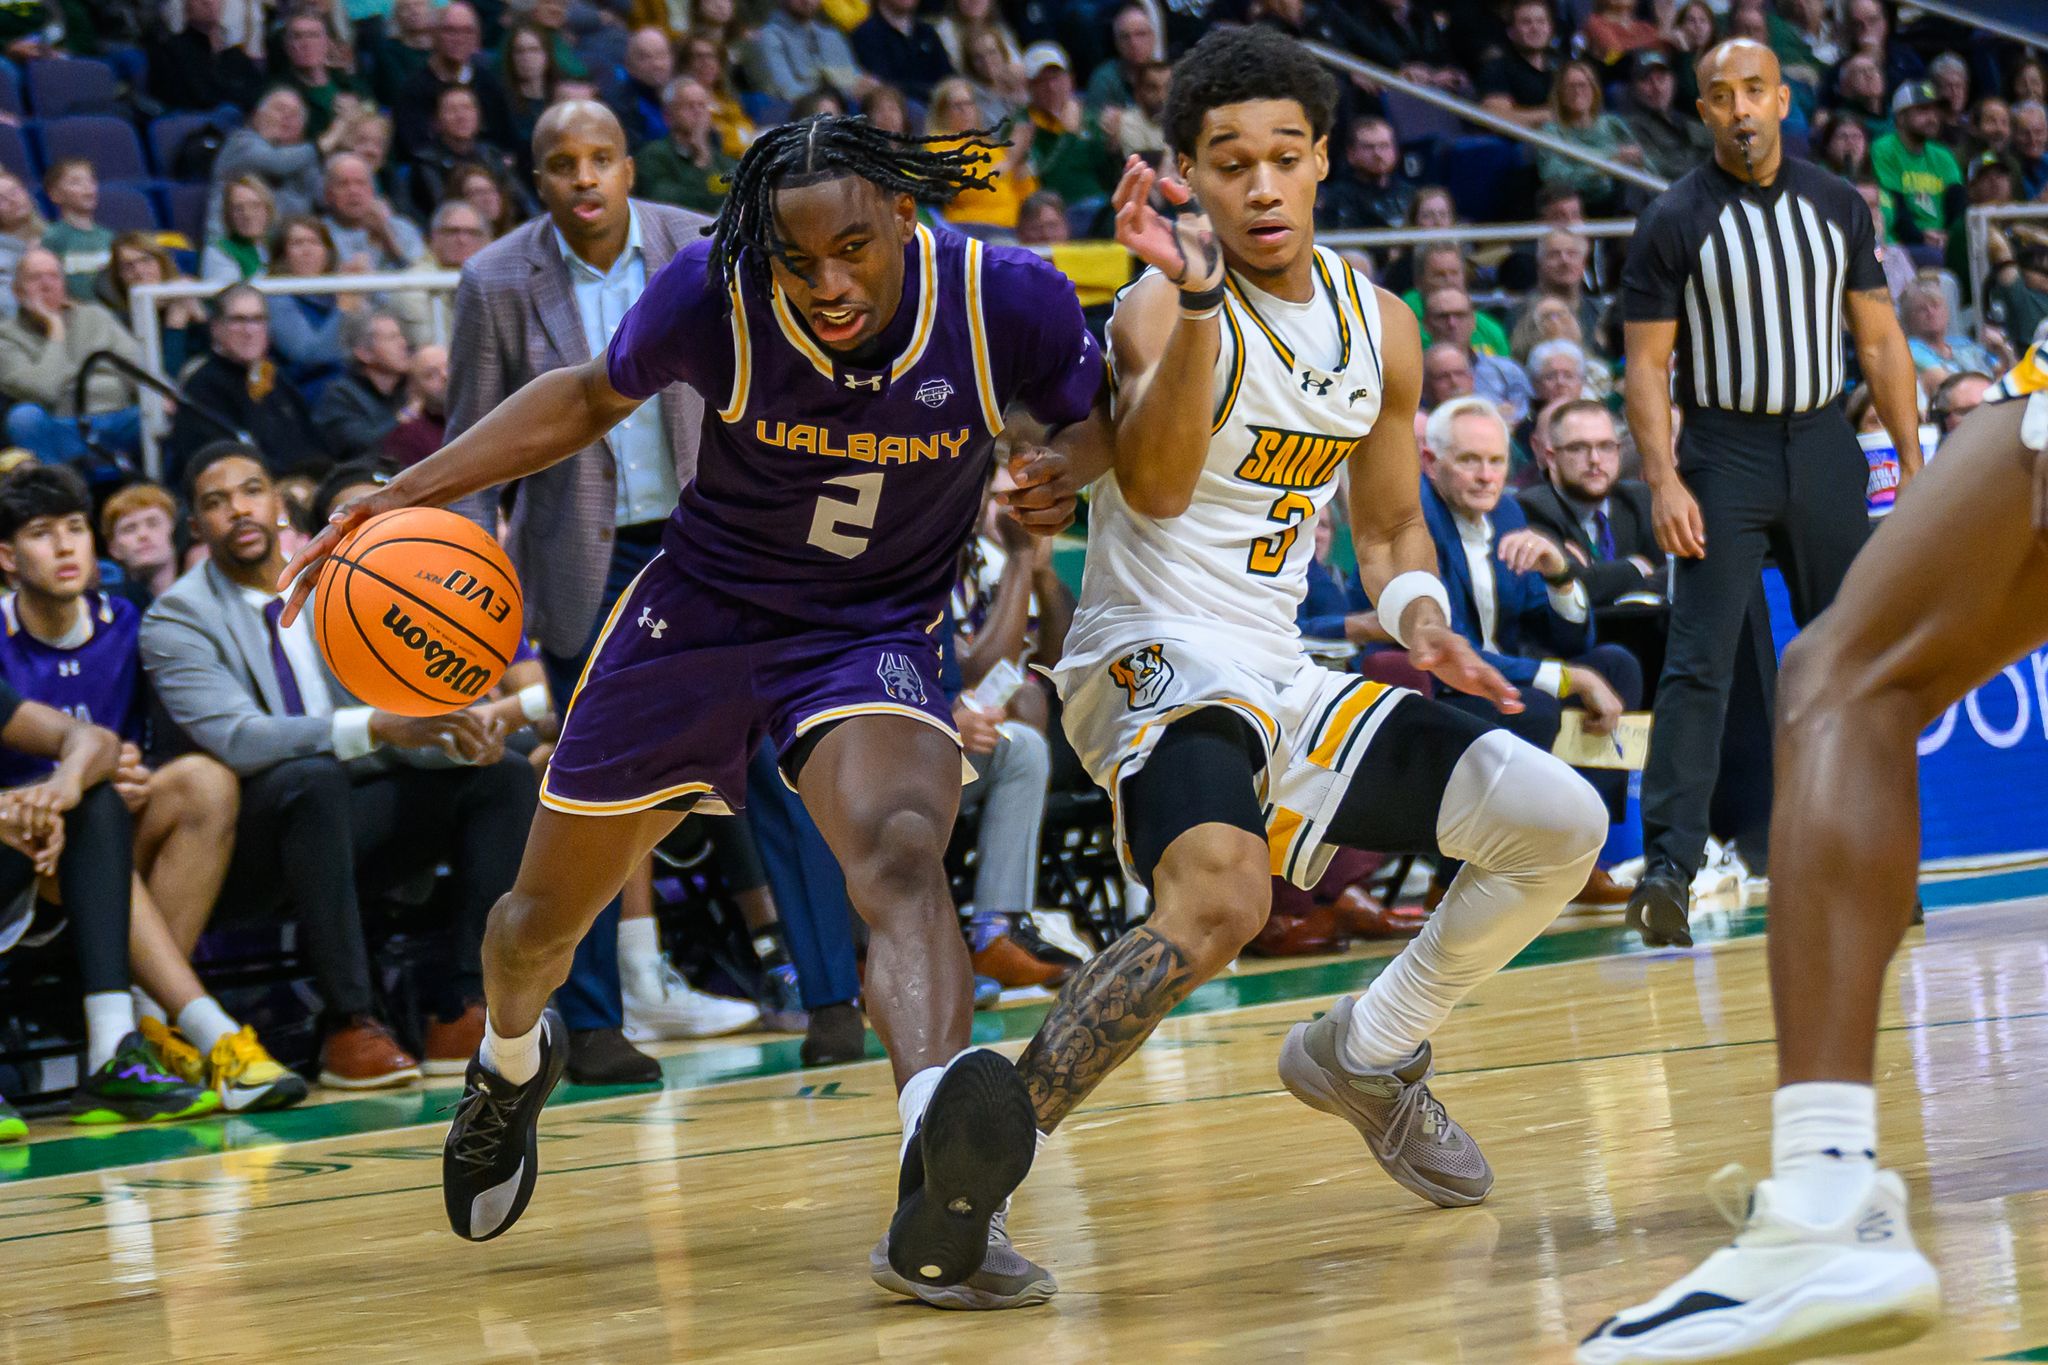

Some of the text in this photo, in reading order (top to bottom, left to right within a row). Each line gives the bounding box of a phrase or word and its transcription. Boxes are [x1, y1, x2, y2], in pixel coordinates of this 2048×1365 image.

[756, 420, 969, 465] UALBANY
[806, 472, 885, 560] 2
[1247, 491, 1315, 577] 3
[383, 603, 491, 697] Wilson
